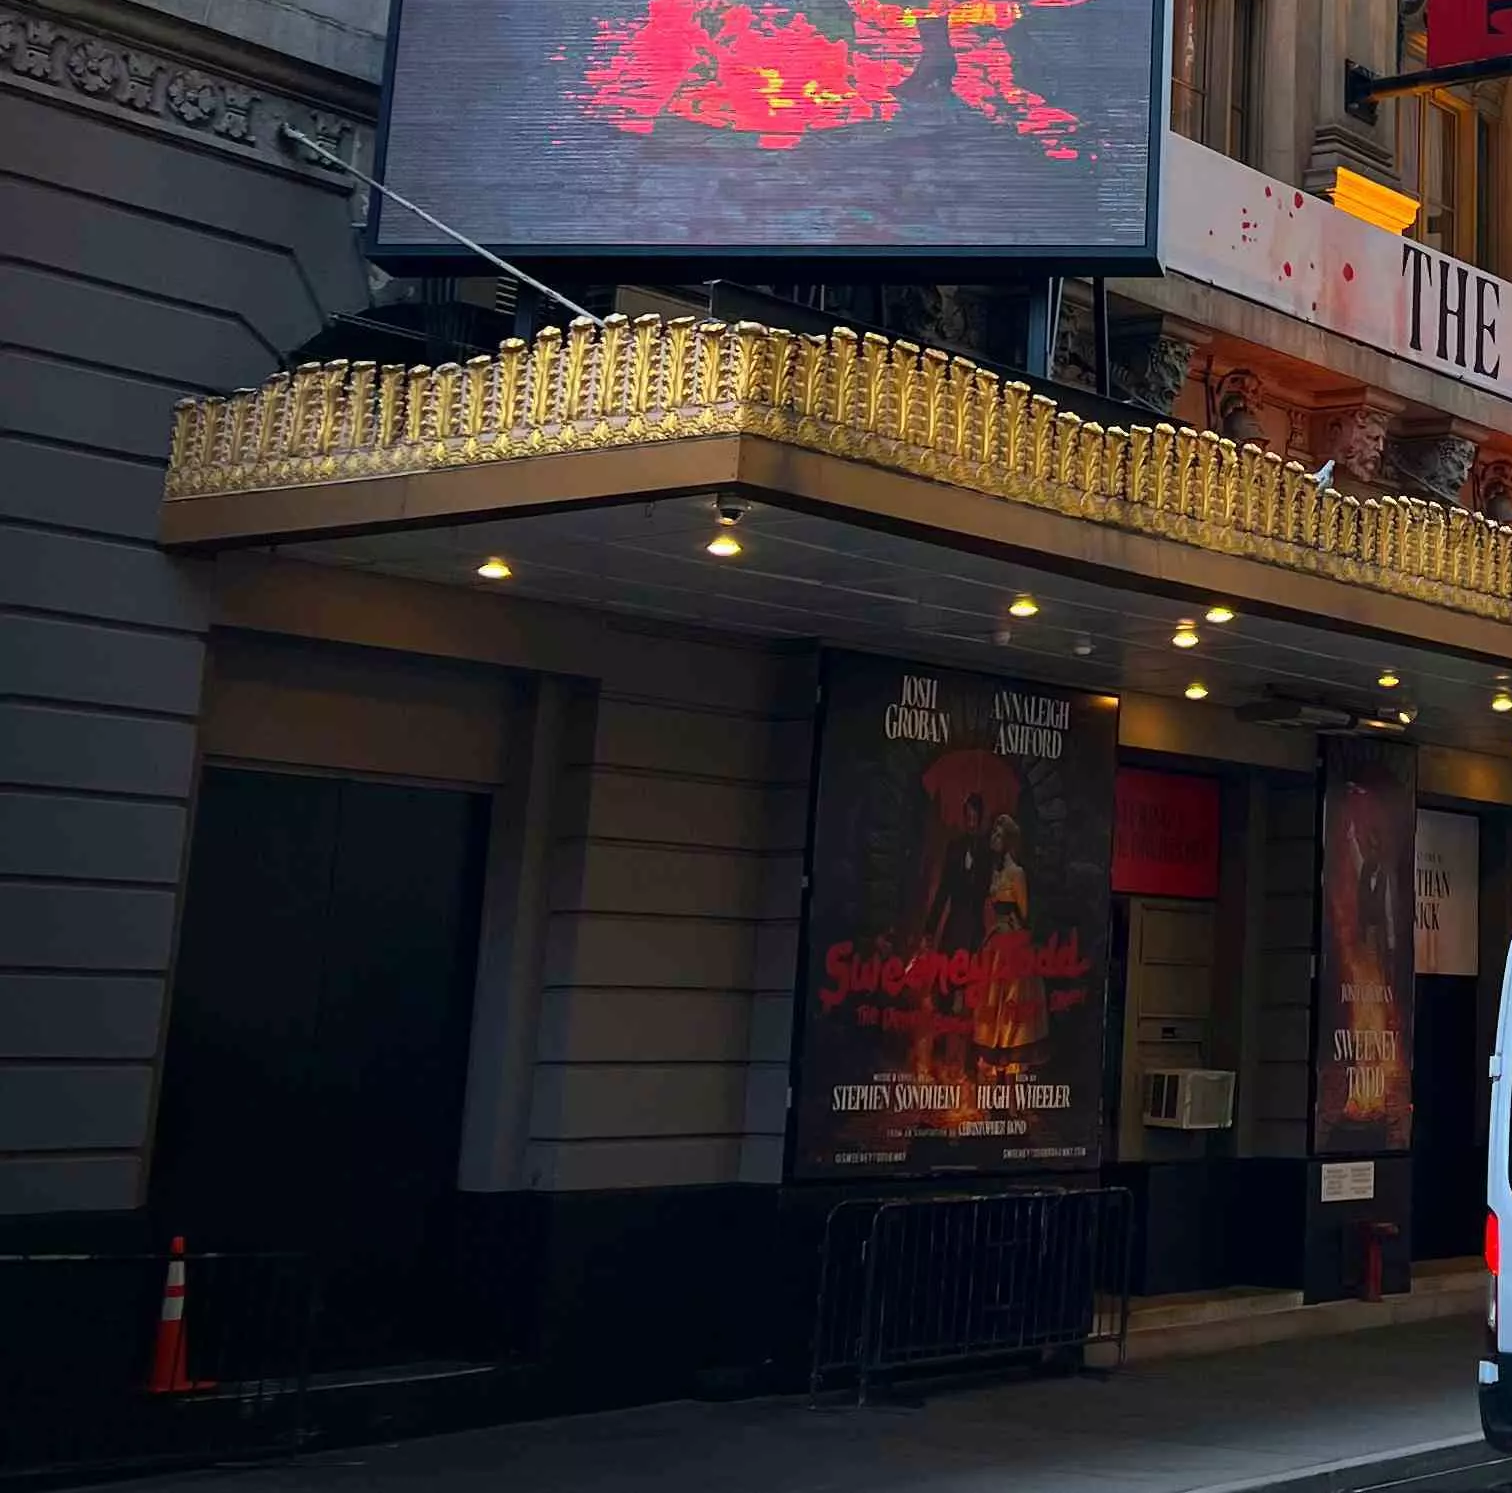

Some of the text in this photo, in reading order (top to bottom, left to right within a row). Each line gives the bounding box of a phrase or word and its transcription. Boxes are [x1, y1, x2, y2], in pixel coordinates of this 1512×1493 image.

[1401, 243, 1500, 380] THE
[901, 675, 1070, 731] JOSH ANNALEIGH
[885, 704, 1063, 760] GROBAN ASHFORD
[1334, 1028, 1399, 1062] SWEENEY
[832, 1083, 961, 1112] STEPHEN SONDHEIM
[977, 1084, 1072, 1111] HUGH WHEELER
[1345, 1065, 1385, 1099] TODD
